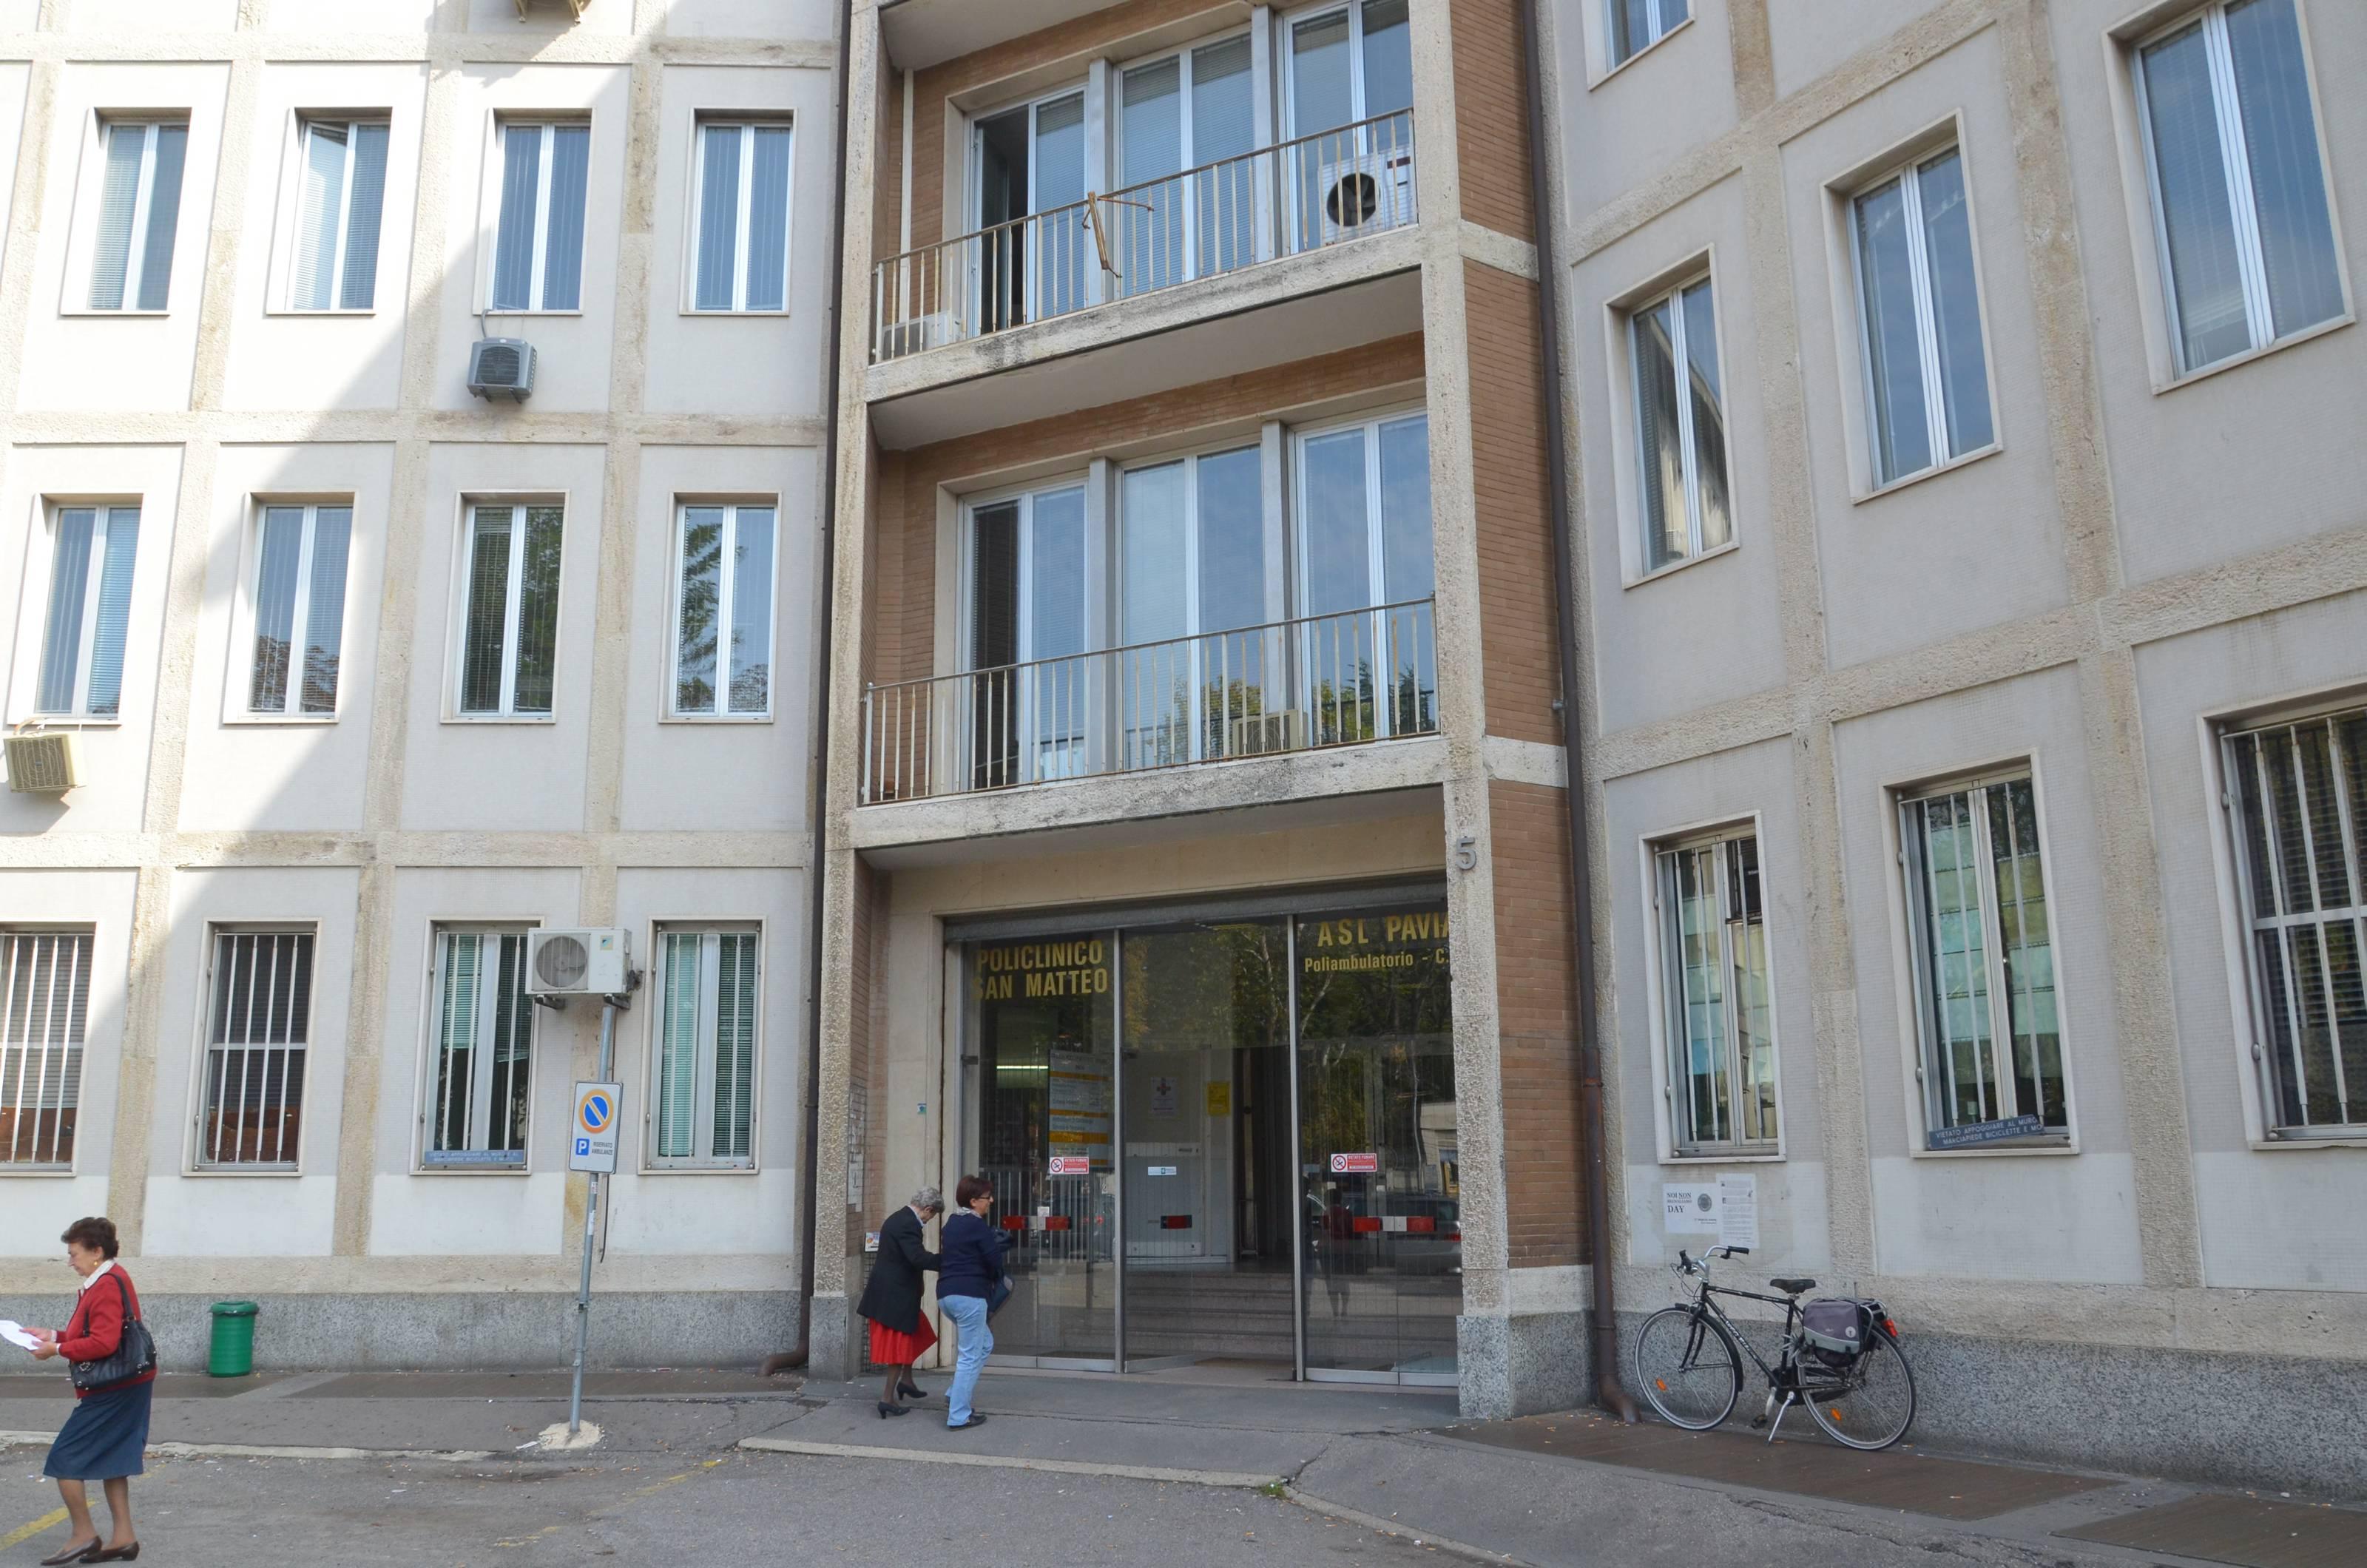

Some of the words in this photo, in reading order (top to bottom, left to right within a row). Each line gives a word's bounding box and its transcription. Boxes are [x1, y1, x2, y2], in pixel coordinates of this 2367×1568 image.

[1455, 837, 1476, 870] 5
[976, 940, 1103, 973] POLICLINICO
[1304, 951, 1414, 973] Poliambulatorio
[971, 974, 1013, 1001] SAN
[1025, 967, 1108, 998] MATTEO
[1935, 1129, 1961, 1139] VIETATO
[1964, 1122, 2005, 1135] APPOGGIARE
[2019, 1116, 2038, 1126] MURO
[1942, 1134, 1983, 1145] MARCIAPIEDE
[1985, 1126, 2021, 1138] BICICLETTE
[578, 1140, 587, 1154] P
[1667, 1205, 1684, 1213] DAY
